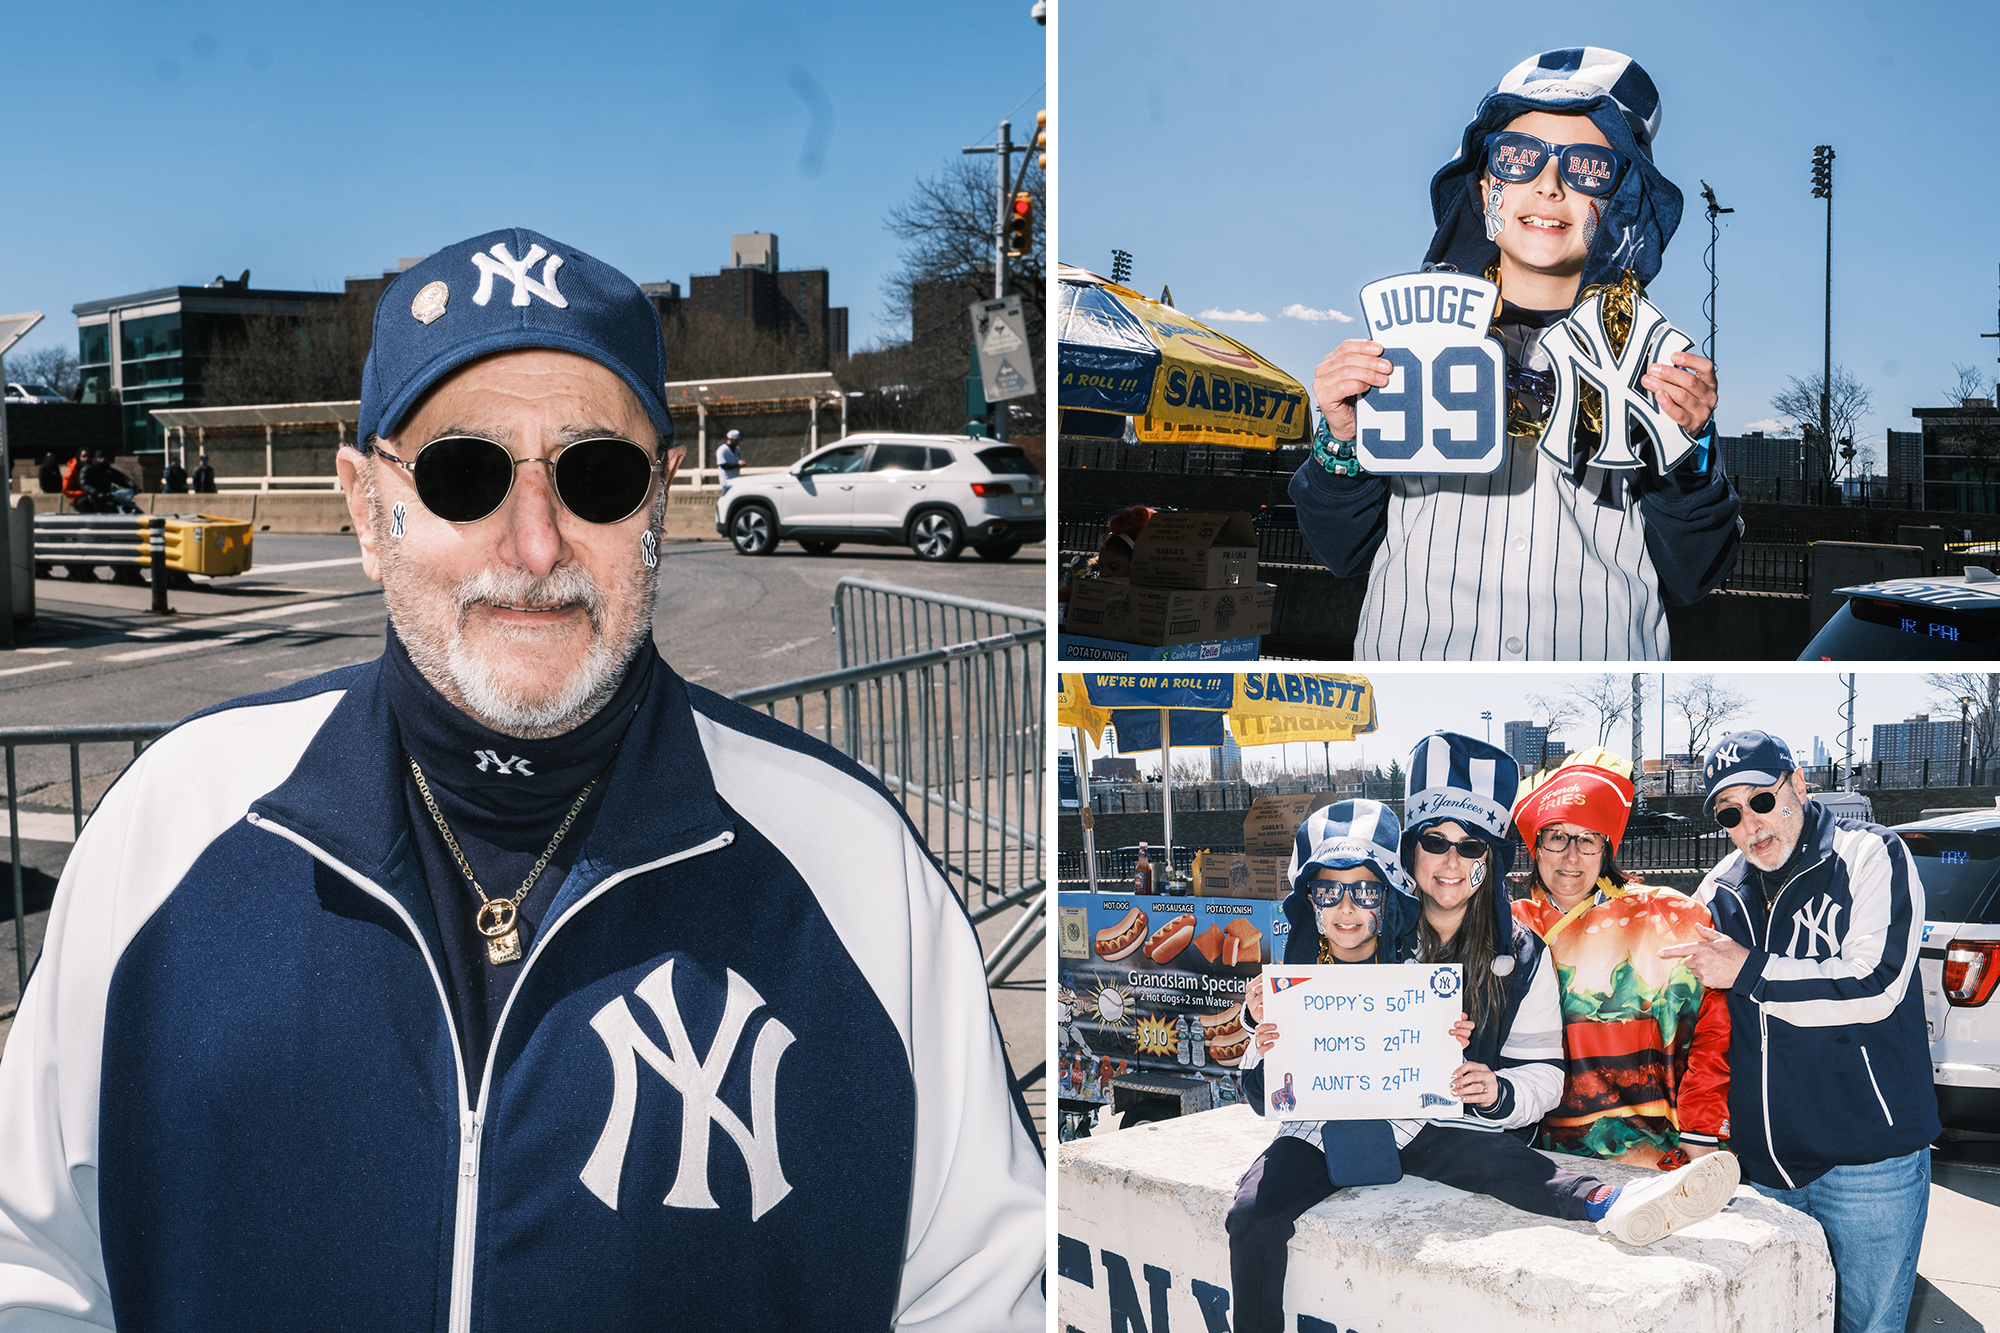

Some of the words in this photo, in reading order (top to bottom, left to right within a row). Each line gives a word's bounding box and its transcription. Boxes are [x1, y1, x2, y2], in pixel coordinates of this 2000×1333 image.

[1499, 146, 1540, 167] PLAY
[1568, 156, 1610, 179] BALL
[471, 243, 569, 308] NY
[1374, 285, 1485, 332] JUDGE
[1062, 373, 1073, 385] A
[1078, 374, 1114, 390] ROLL
[1119, 378, 1138, 392] !!!
[1538, 291, 1699, 475] NY
[1164, 365, 1302, 425] SABRETT
[1362, 346, 1496, 460] 99
[1276, 424, 1291, 434] 2023
[391, 504, 406, 536] NY
[1067, 645, 1100, 659] POTATO
[1102, 649, 1128, 661] KNISH
[1171, 651, 1186, 660] Cash
[1186, 650, 1198, 659] App
[1201, 647, 1219, 659] Zelle
[1097, 675, 1136, 687] WE'RE
[1140, 677, 1157, 688] ON
[1160, 678, 1169, 688] A
[1173, 678, 1203, 689] ROLL
[1206, 679, 1221, 690] !!!
[1244, 673, 1366, 712] SABRETT
[1345, 712, 1359, 721] 2023
[473, 749, 535, 777] NY
[1715, 743, 1741, 771] NY
[1540, 783, 1581, 804] French
[1430, 794, 1484, 815] Yankees
[1537, 794, 1586, 816] FRIES
[1317, 888, 1339, 899] PLAY
[1103, 901, 1116, 910] HOT
[1116, 902, 1130, 910] DOG
[1152, 903, 1166, 912] HOT
[1166, 904, 1195, 913] SAUSAGE
[1206, 905, 1232, 914] POTATO
[1232, 905, 1253, 915] KNISH
[1273, 920, 1292, 935] Gra
[1785, 893, 1842, 958] NY
[1128, 970, 1198, 991] Grandslam
[1440, 976, 1451, 990] NY
[1140, 991, 1145, 1001] 2
[1146, 991, 1160, 1002] Hot
[1192, 997, 1204, 1006] sm
[1205, 996, 1234, 1008] Waters
[1304, 994, 1375, 1012] POPPY'S
[1386, 989, 1425, 1012] 50TH
[1143, 1026, 1167, 1046] $10
[1314, 1036, 1365, 1052] MOM'S
[1383, 1029, 1420, 1052] 29TH
[1312, 1075, 1371, 1091] AUNT'S
[1382, 1067, 1420, 1091] 29TH
[579, 958, 796, 1222] NY
[1424, 1093, 1438, 1104] NEW
